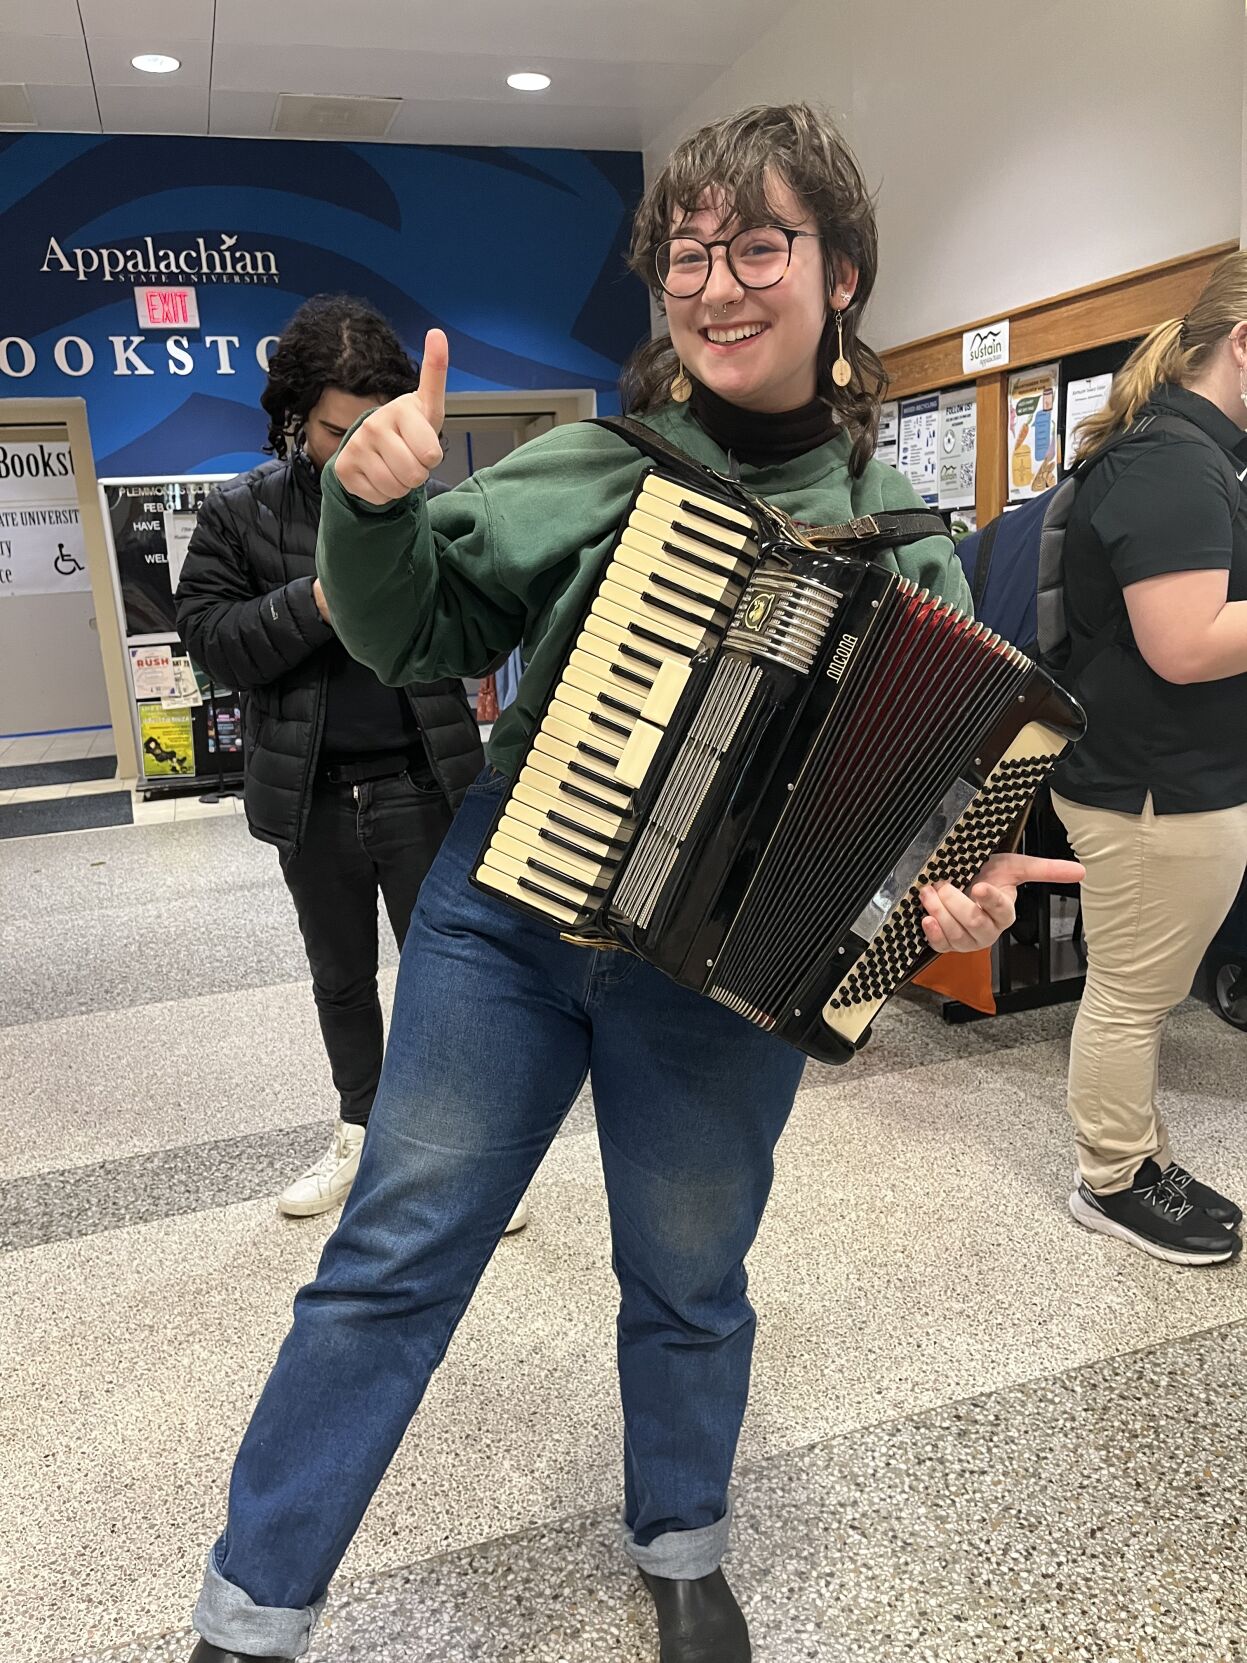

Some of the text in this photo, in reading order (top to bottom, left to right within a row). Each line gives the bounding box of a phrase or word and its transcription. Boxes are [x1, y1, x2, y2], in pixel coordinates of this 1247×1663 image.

[40, 233, 280, 281] Appalachian
[118, 273, 280, 285] STATE UNIVERSITY
[145, 290, 189, 325] EXIT
[969, 338, 1002, 361] sustain
[20, 509, 79, 527] UNIVERSIT
[133, 520, 161, 532] HAVE
[144, 553, 168, 564] WEL
[136, 658, 170, 669] RUSH
